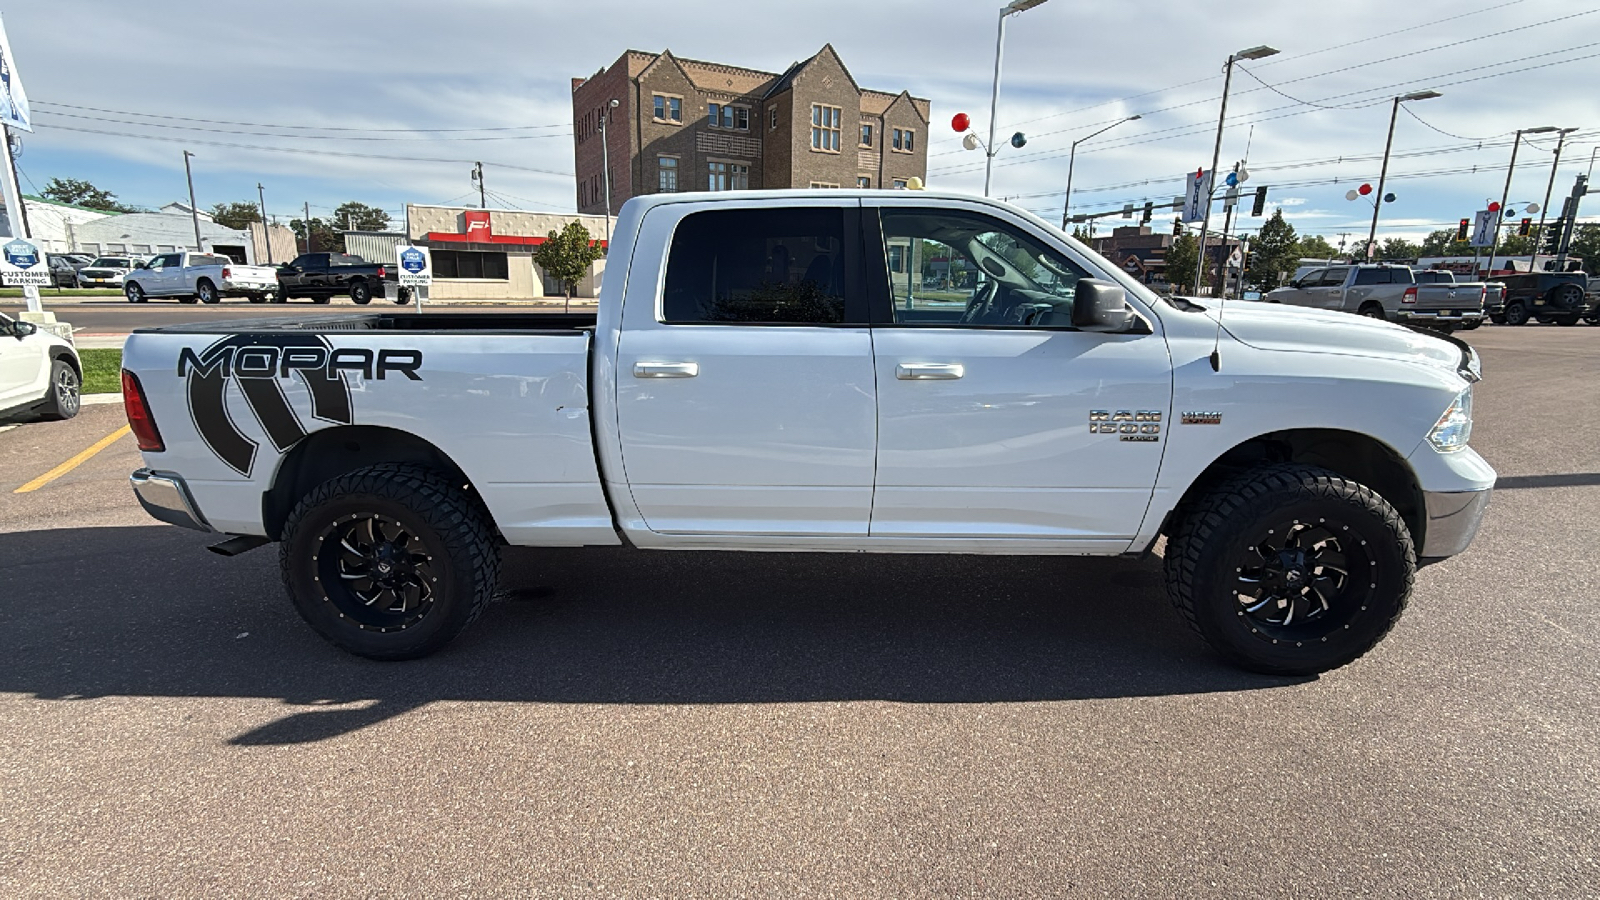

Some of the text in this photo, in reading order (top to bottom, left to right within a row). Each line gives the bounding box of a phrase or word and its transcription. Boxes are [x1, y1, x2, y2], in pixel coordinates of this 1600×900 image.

[177, 346, 423, 381] MOPAR
[1089, 410, 1162, 422] RAM
[1181, 411, 1222, 420] HEMI
[1089, 423, 1160, 434] 1500
